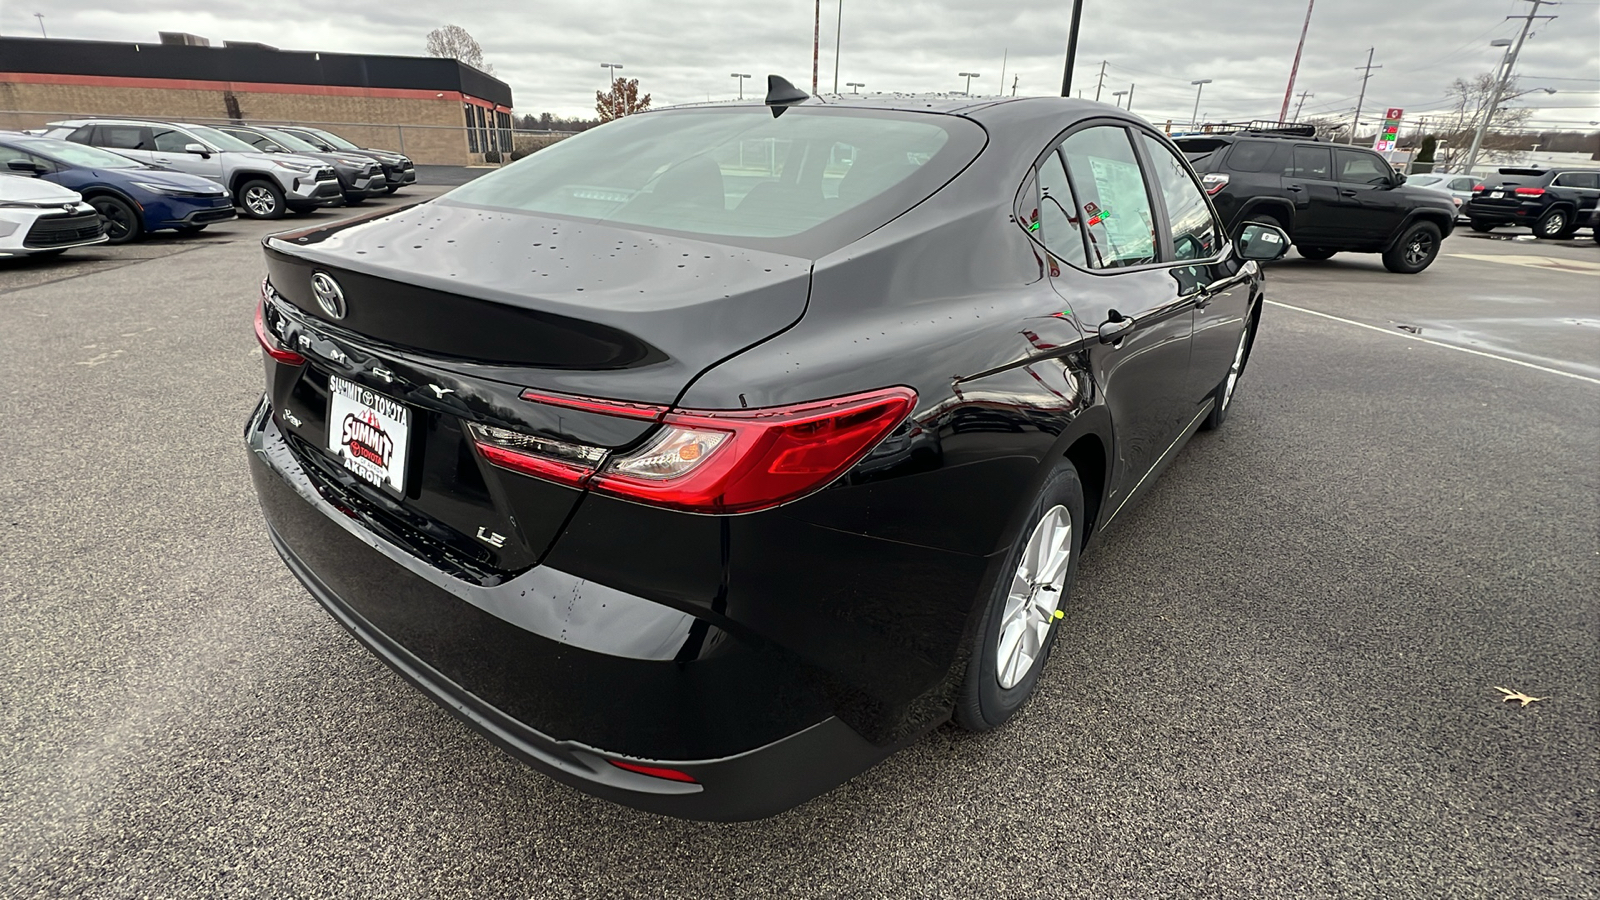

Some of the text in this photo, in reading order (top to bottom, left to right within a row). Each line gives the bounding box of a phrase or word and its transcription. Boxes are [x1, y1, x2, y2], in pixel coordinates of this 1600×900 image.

[276, 312, 454, 399] CAMRY
[329, 374, 407, 426] SUMMIT TOYOTA
[342, 414, 393, 469] SUMMIT
[361, 446, 383, 467] TOYOTA
[344, 457, 383, 488] AKRON
[476, 526, 506, 548] LE
